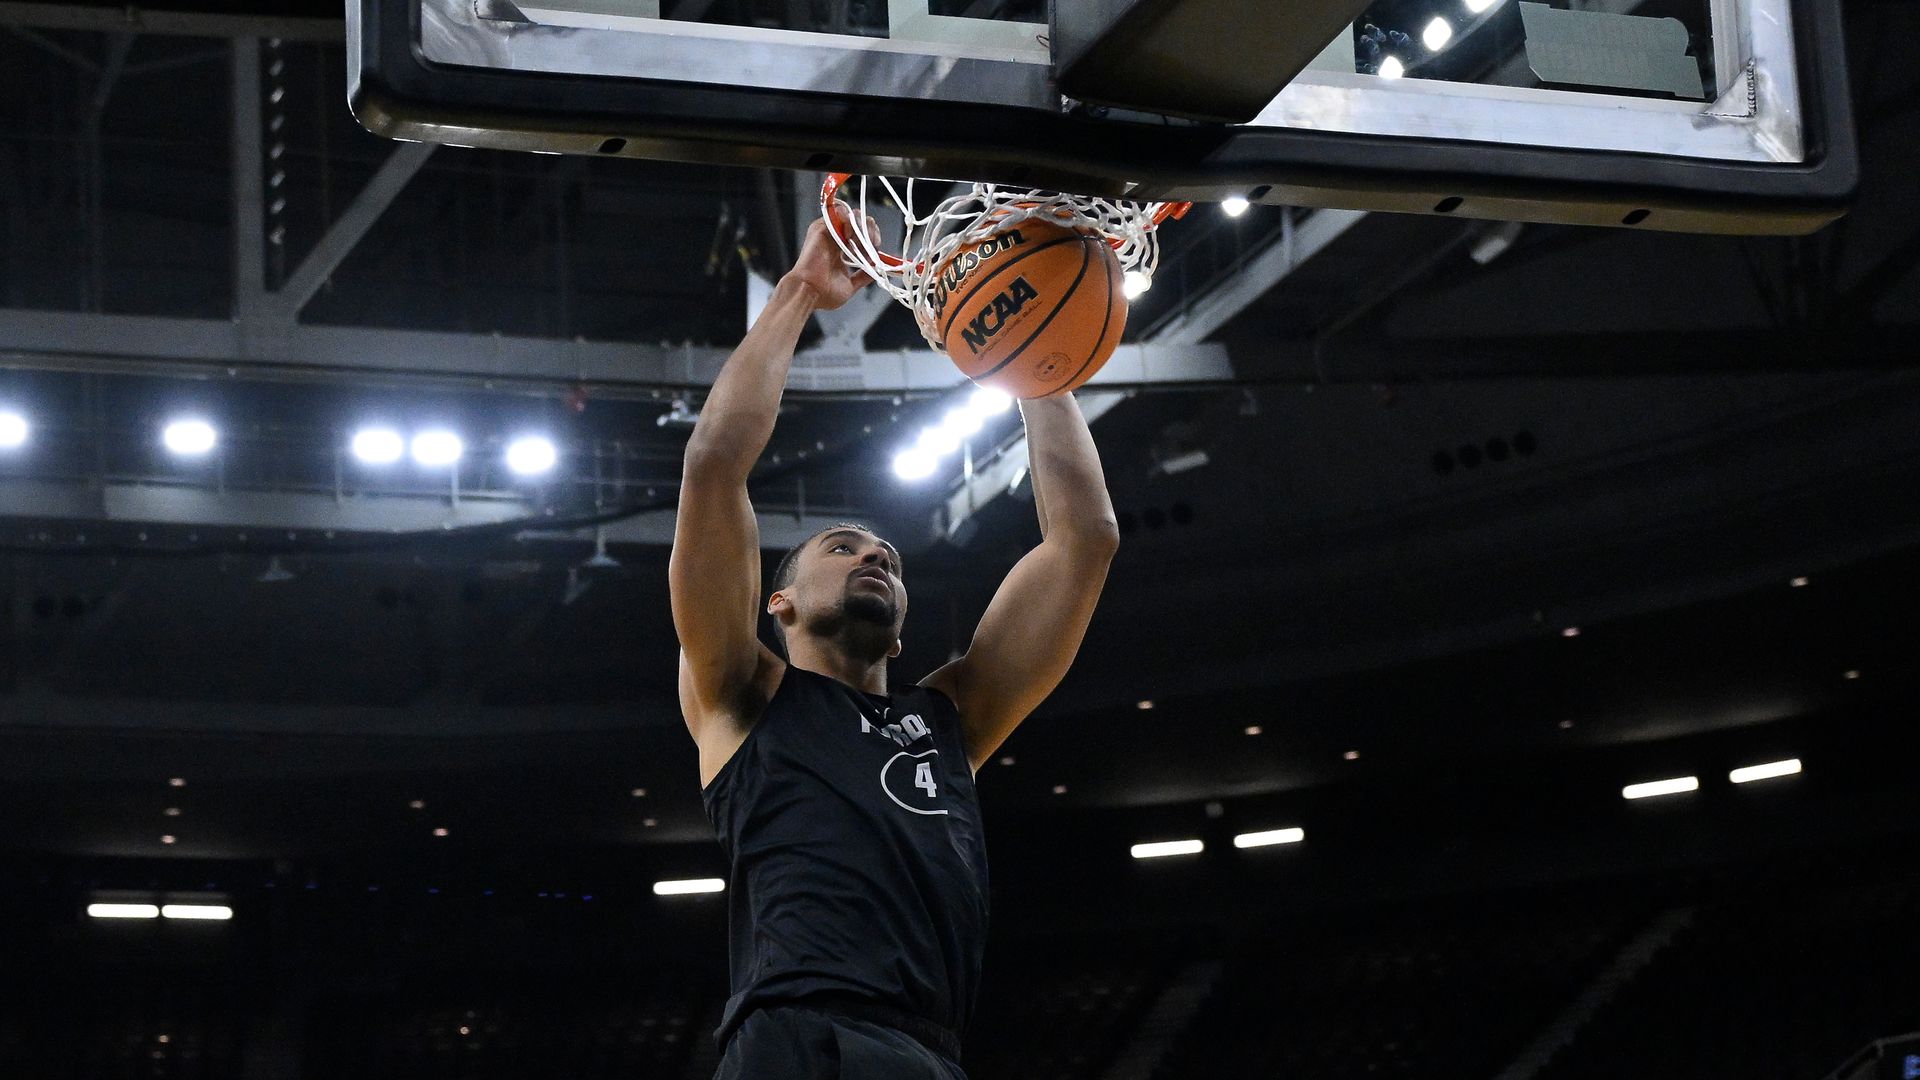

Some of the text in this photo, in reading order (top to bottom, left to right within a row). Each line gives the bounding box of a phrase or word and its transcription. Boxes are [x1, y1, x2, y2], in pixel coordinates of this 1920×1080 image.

[935, 229, 1024, 319] Wilson
[961, 276, 1038, 354] NCAA
[1022, 300, 1043, 318] BALL
[915, 762, 937, 798] 4
